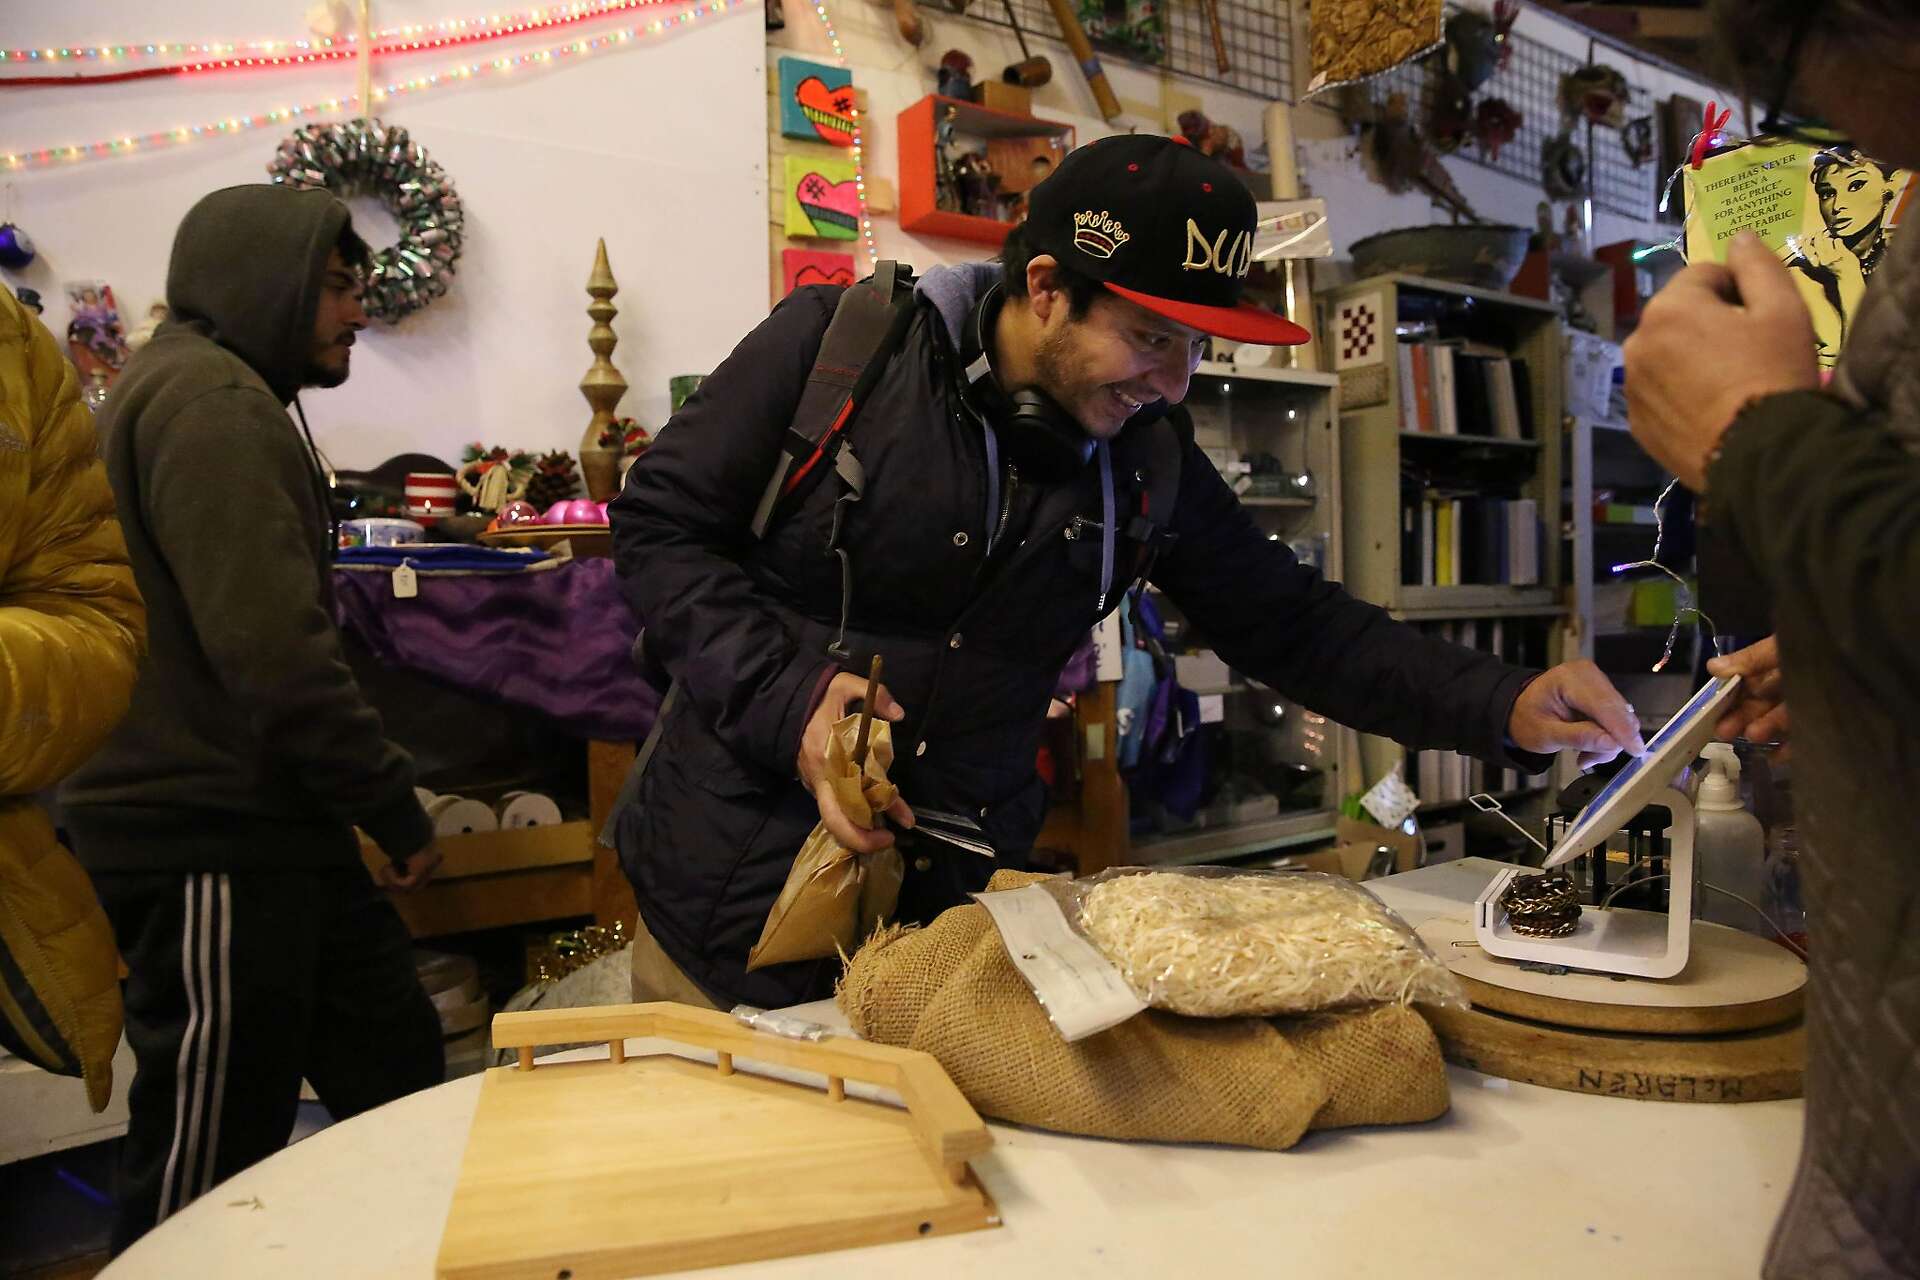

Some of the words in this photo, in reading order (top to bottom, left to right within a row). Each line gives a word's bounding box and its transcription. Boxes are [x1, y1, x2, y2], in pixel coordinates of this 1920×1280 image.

[1705, 176, 1737, 193] THERE
[1738, 167, 1759, 181] HAS
[1761, 154, 1796, 170] NEVER
[1733, 179, 1758, 193] BEEN
[1760, 175, 1769, 184] A
[1714, 208, 1735, 221] FOR
[1737, 187, 1792, 213] ANYTHING
[1730, 215, 1743, 226] AT
[1745, 203, 1779, 221] SCRAP
